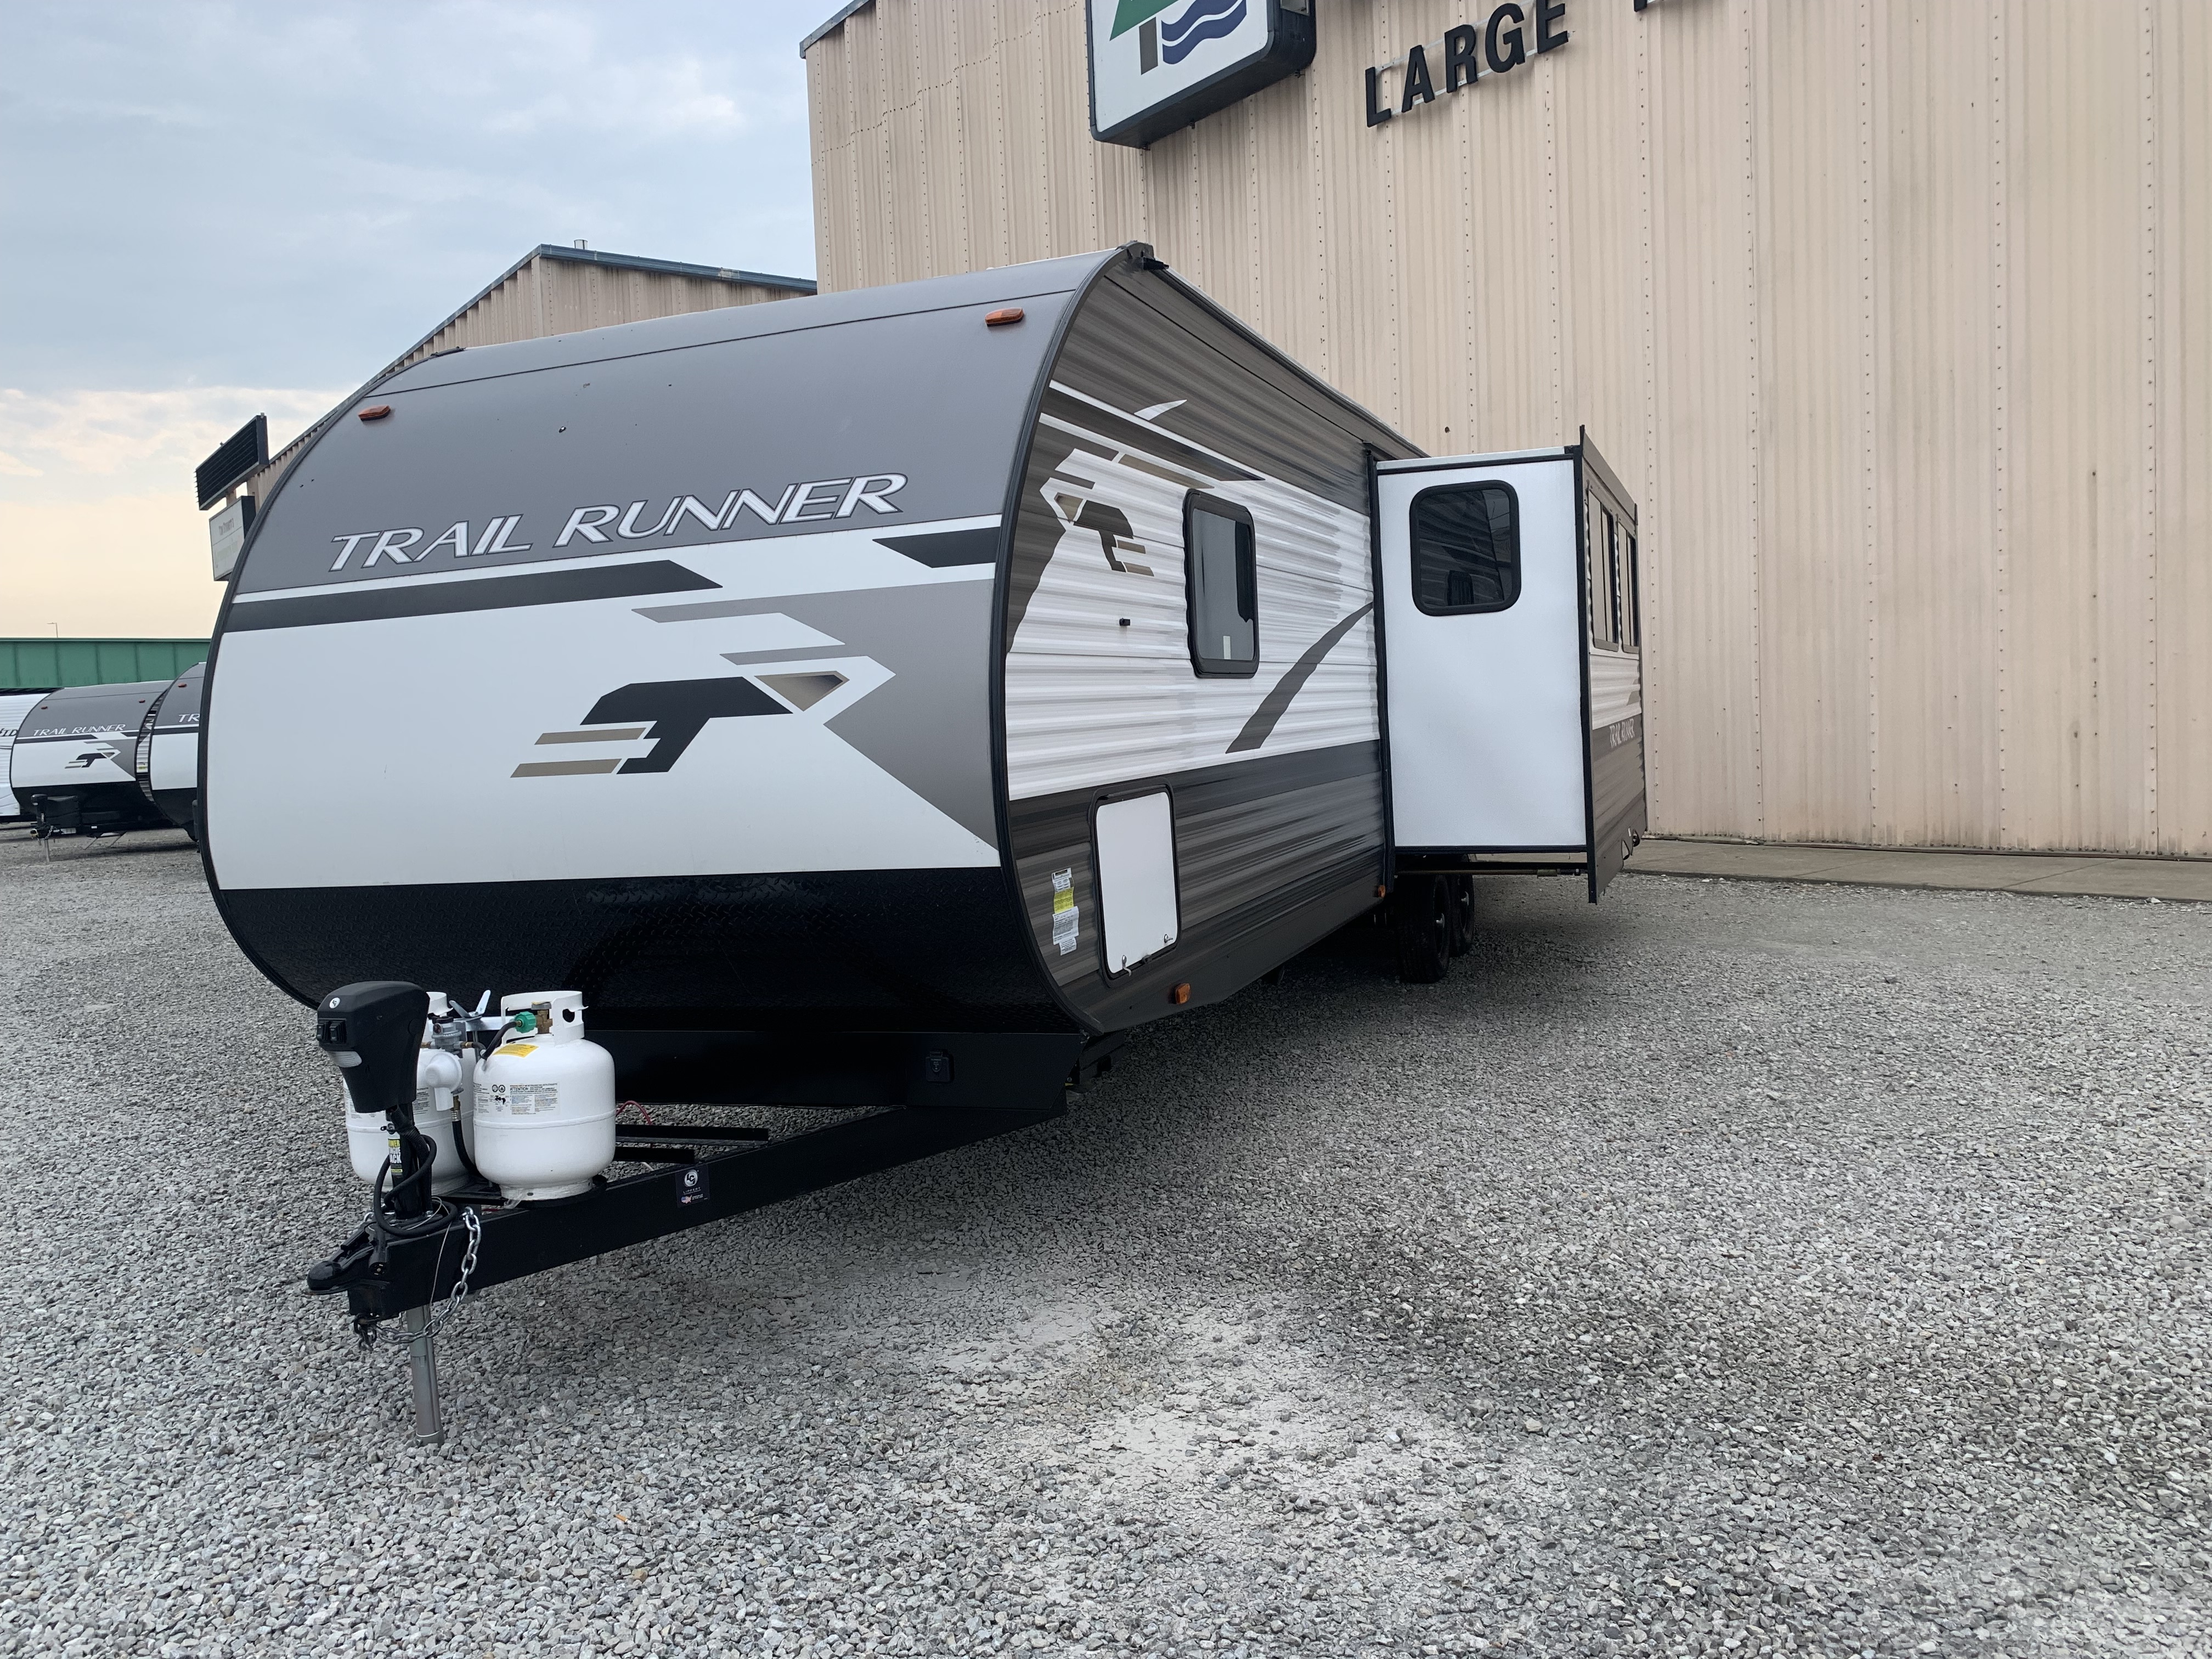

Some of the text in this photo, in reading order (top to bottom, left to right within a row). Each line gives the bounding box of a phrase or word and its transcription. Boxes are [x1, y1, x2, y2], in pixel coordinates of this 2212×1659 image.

[1365, 0, 1569, 127] LARGE
[329, 472, 908, 572] TRAIL RUNNER
[33, 724, 126, 736] TRAIL RUNNER
